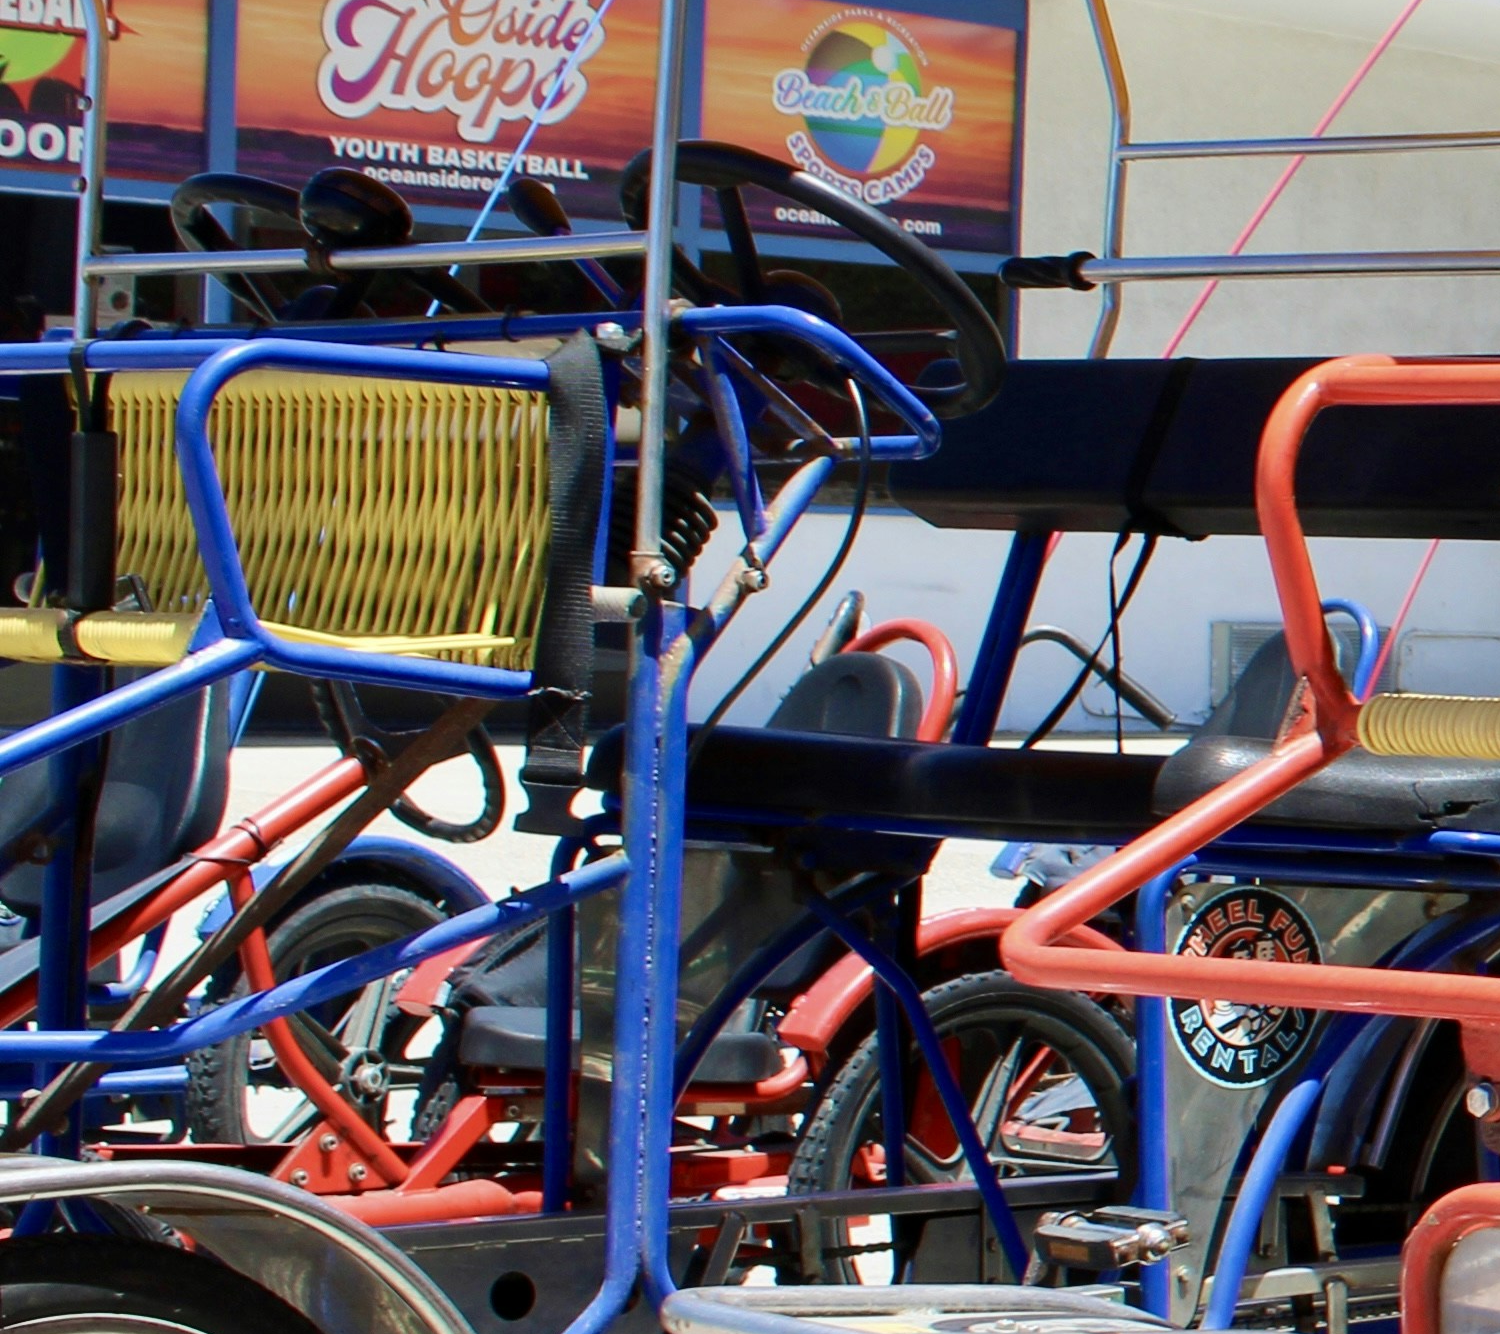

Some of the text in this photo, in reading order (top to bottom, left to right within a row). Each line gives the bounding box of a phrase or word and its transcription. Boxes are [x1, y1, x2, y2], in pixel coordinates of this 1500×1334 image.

[844, 8, 873, 18] PARKS
[886, 16, 930, 67] RECREATION
[775, 72, 950, 125] Beach & Ball
[328, 135, 589, 181] YOUTH BASKETBALL
[788, 134, 933, 201] SPORTS CAMPS
[1179, 1004, 1306, 1075] RENTALS
